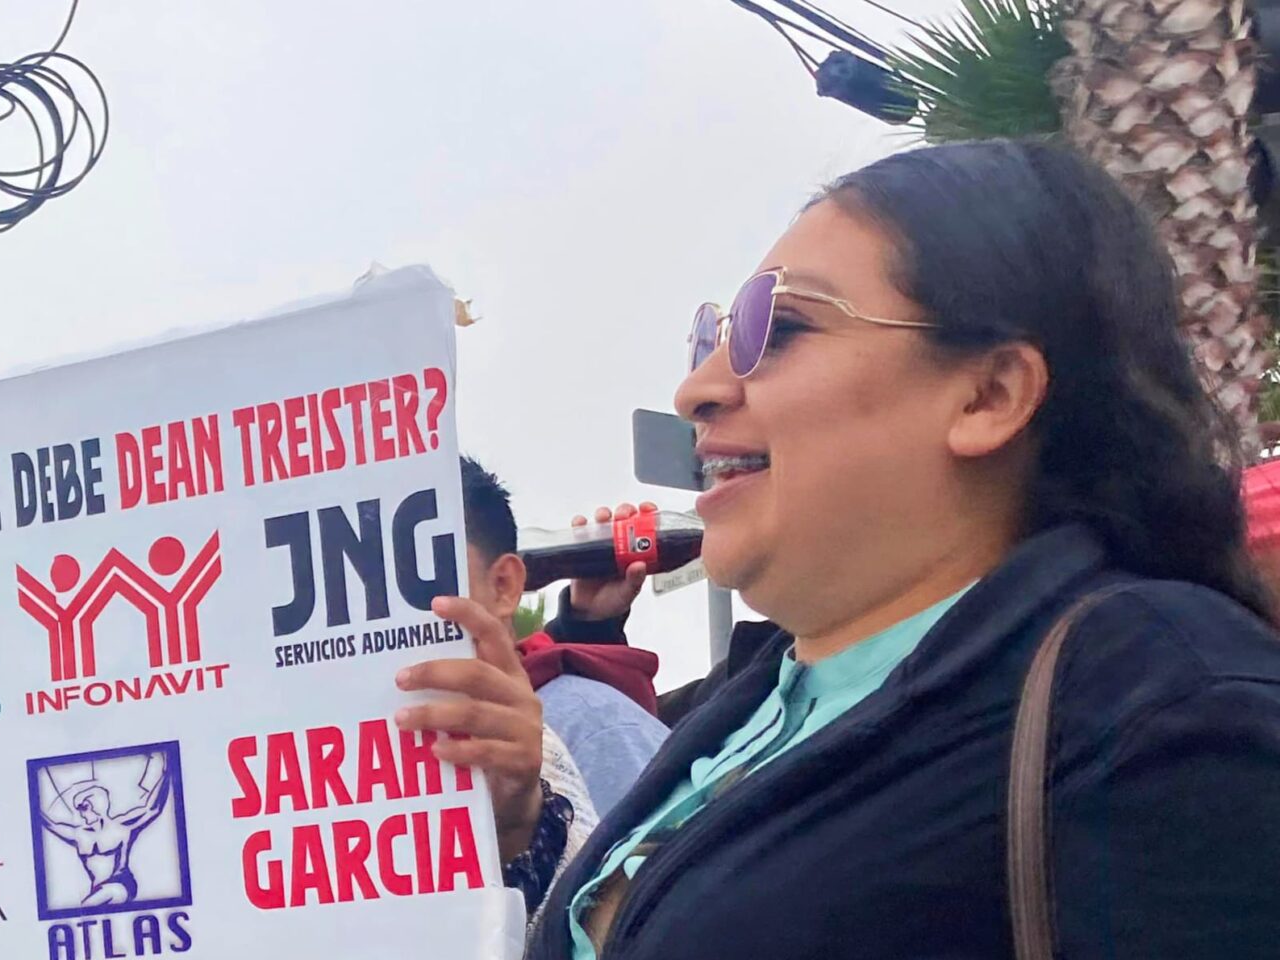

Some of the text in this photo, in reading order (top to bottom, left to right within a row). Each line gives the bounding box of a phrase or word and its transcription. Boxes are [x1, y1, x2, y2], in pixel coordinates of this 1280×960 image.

[11, 438, 106, 528] DEBE
[115, 414, 225, 510] DEAN
[232, 367, 448, 487] TREISTER?
[263, 488, 459, 637] JNG
[25, 664, 230, 716] INFONAVIT
[275, 620, 464, 668] SERVICIOS ADUANALES
[242, 806, 485, 910] GARCIA
